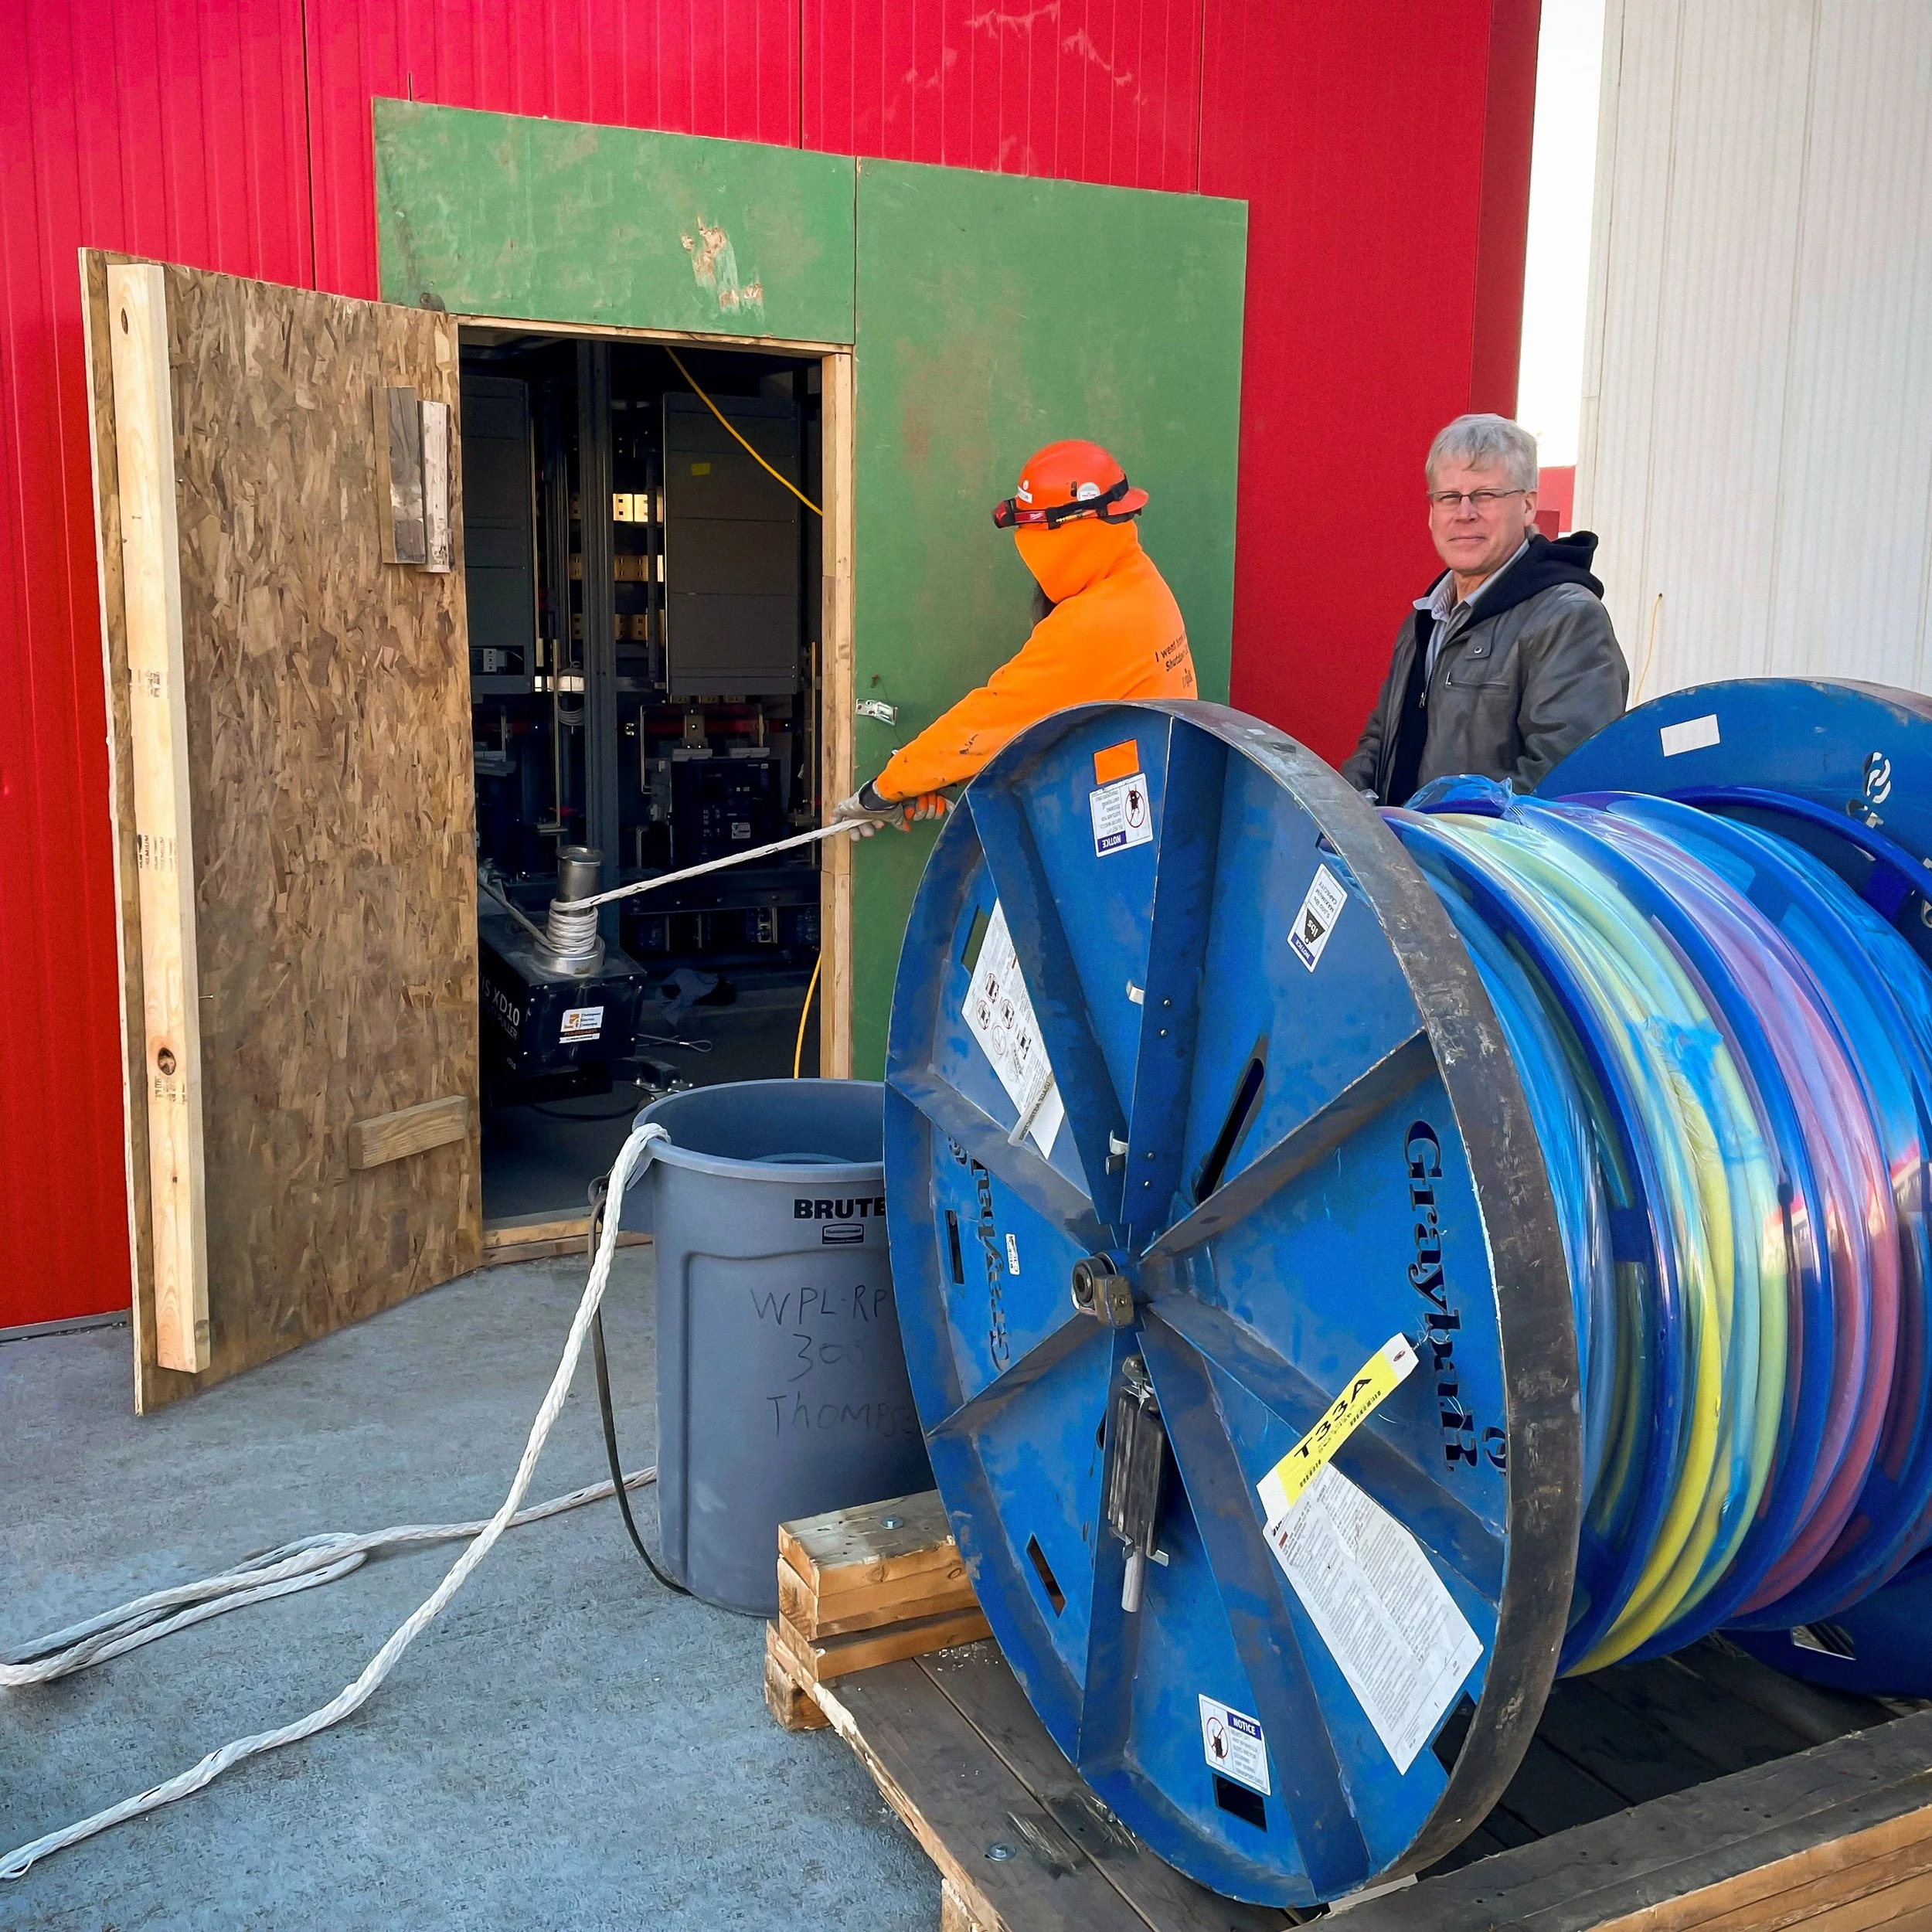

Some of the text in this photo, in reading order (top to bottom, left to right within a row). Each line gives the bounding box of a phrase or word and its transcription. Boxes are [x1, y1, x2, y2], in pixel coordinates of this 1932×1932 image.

[1101, 835, 1121, 849] NOTICE
[1318, 881, 1338, 905] CAPACITY
[1307, 919, 1319, 937] lbs
[1295, 939, 1311, 959] NOTICE
[492, 986, 520, 1026] XD10
[794, 1196, 886, 1219] BRUTE
[1294, 1378, 1372, 1459] T33A
[1233, 1716, 1256, 1736] NOTICE
